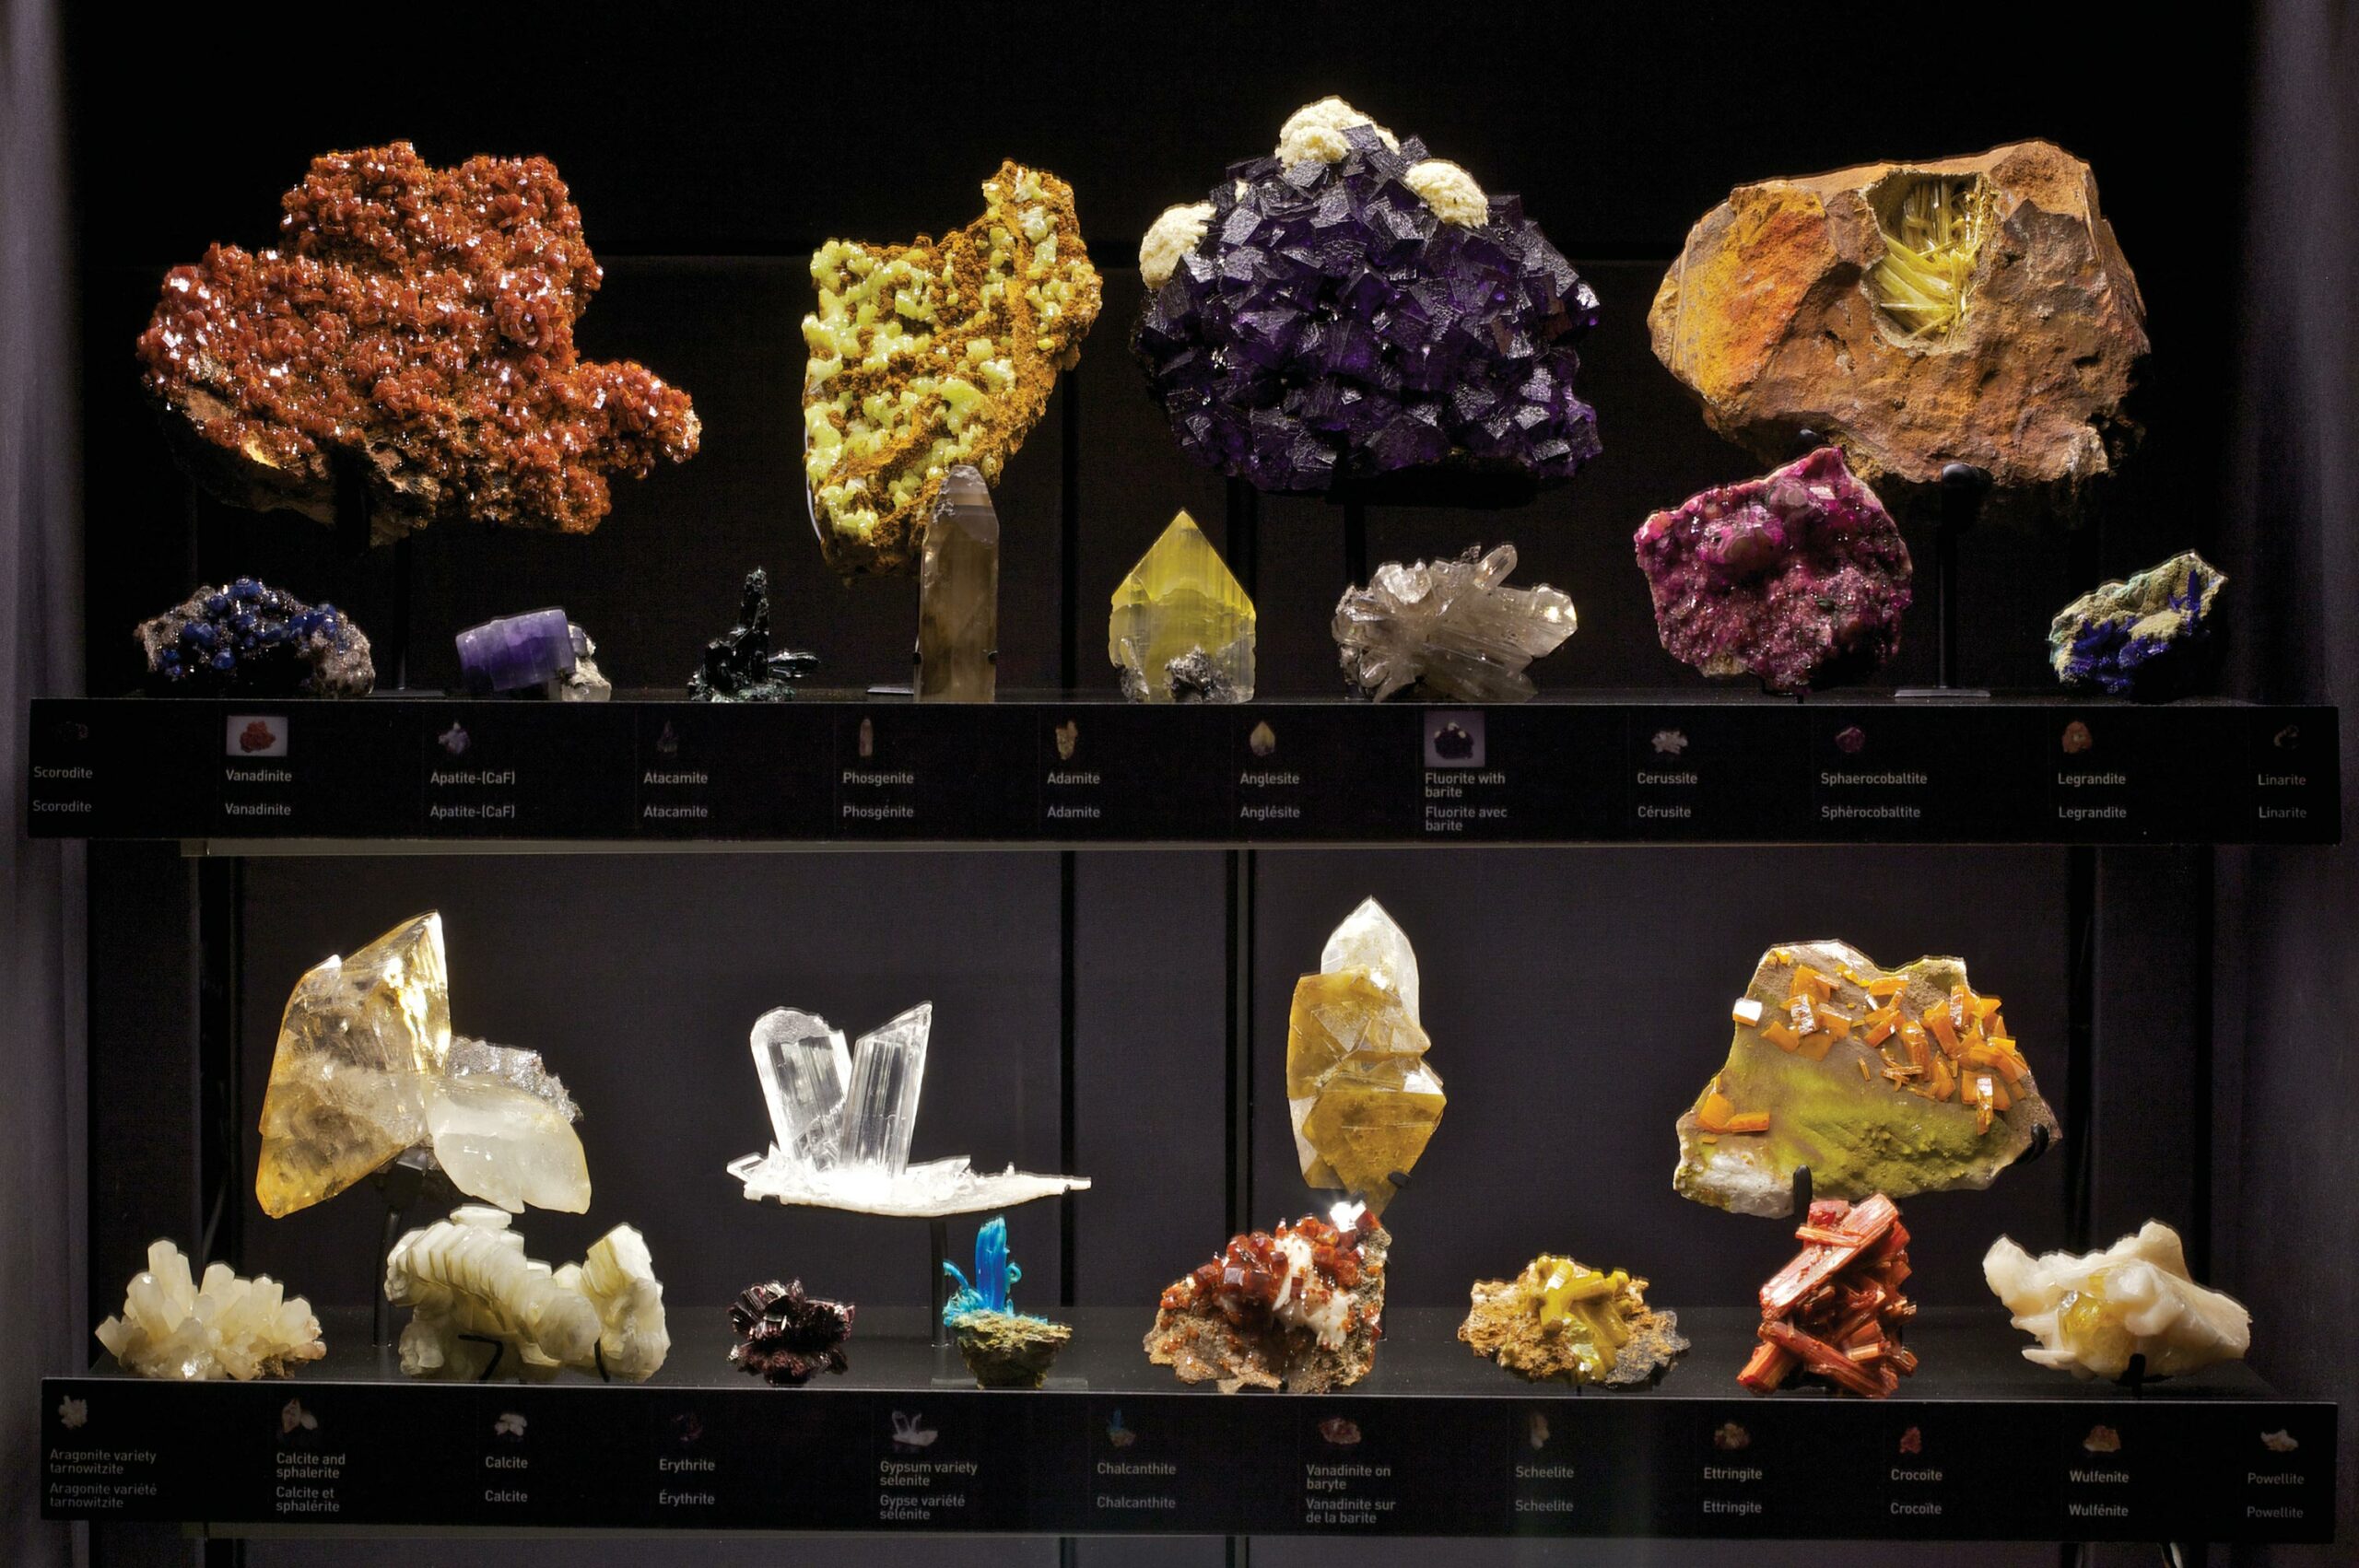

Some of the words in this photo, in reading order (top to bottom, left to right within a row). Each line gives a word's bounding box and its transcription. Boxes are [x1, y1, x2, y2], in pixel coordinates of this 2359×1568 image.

[34, 766, 93, 778] Scorodite
[226, 768, 293, 782] Vanadinite
[644, 771, 709, 785] Atacamite
[1048, 771, 1101, 785] Adamite
[1425, 772, 1475, 785] Fluorite
[1478, 772, 1506, 784] with
[1637, 771, 1698, 785] Cerussite
[1821, 771, 1928, 787] Sphaerocobaltite
[843, 771, 915, 788] Phosgenite
[1240, 771, 1300, 788] Anglesite
[2059, 772, 2127, 788] Legrandite
[2259, 773, 2306, 786] Linarite
[1425, 786, 1463, 798] barite
[33, 800, 92, 813] Scorodite
[225, 802, 292, 816] Vanadinite
[644, 804, 709, 818] Atacamite
[843, 804, 914, 821] Phosgénite
[1048, 805, 1101, 818] Adamite
[1240, 804, 1301, 822] Anglésite
[1426, 805, 1476, 818] Fluorite
[1478, 808, 1508, 818] avec
[1637, 804, 1692, 818] Cérusite
[2059, 805, 2128, 822] Legrandite
[2259, 805, 2307, 818] Linarite
[1426, 819, 1463, 832] barite
[50, 1448, 111, 1463] Aragonite
[114, 1449, 157, 1465] variety
[276, 1452, 318, 1465] Calcite
[321, 1453, 346, 1466] and
[486, 1456, 529, 1469] Calcite
[51, 1463, 123, 1475] tarnowitzite
[659, 1457, 716, 1474] Erythrite
[880, 1460, 931, 1475] Gypsum
[933, 1461, 978, 1476] variety
[1097, 1462, 1177, 1476] Chalcanthite
[1306, 1464, 1372, 1477] Vanadinite
[1375, 1468, 1391, 1477] on
[1515, 1465, 1575, 1479] Scheelite
[276, 1466, 340, 1480] sphalerite
[1704, 1466, 1763, 1482] Ettringite
[1890, 1468, 1943, 1481] Crocoite
[2069, 1469, 2130, 1483] Wulfenite
[2248, 1472, 2305, 1485] Powellite
[879, 1474, 931, 1487] selenite
[1307, 1477, 1347, 1492] baryte
[50, 1482, 111, 1497] Aragonite
[114, 1482, 158, 1495] variété
[276, 1486, 319, 1499] Calcite
[322, 1488, 334, 1499] et
[485, 1489, 528, 1503] Calcite
[50, 1496, 124, 1508] tarnowitzite
[659, 1489, 716, 1507] Érythrite
[880, 1494, 918, 1509] Gypse
[921, 1493, 966, 1507] variété
[1097, 1495, 1177, 1509] Chalcanthite
[1306, 1498, 1371, 1511] Vanadinite
[1374, 1501, 1396, 1511] sur
[276, 1499, 340, 1515] sphalérite
[879, 1506, 931, 1520] sélénite
[1515, 1499, 1574, 1513] Scheelite
[1703, 1500, 1763, 1516] Ettringite
[2068, 1503, 2130, 1516] Wulfénite
[2247, 1505, 2304, 1518] Powellite
[1306, 1511, 1322, 1524] de
[1324, 1511, 1337, 1524] la
[1339, 1511, 1378, 1524] barite
